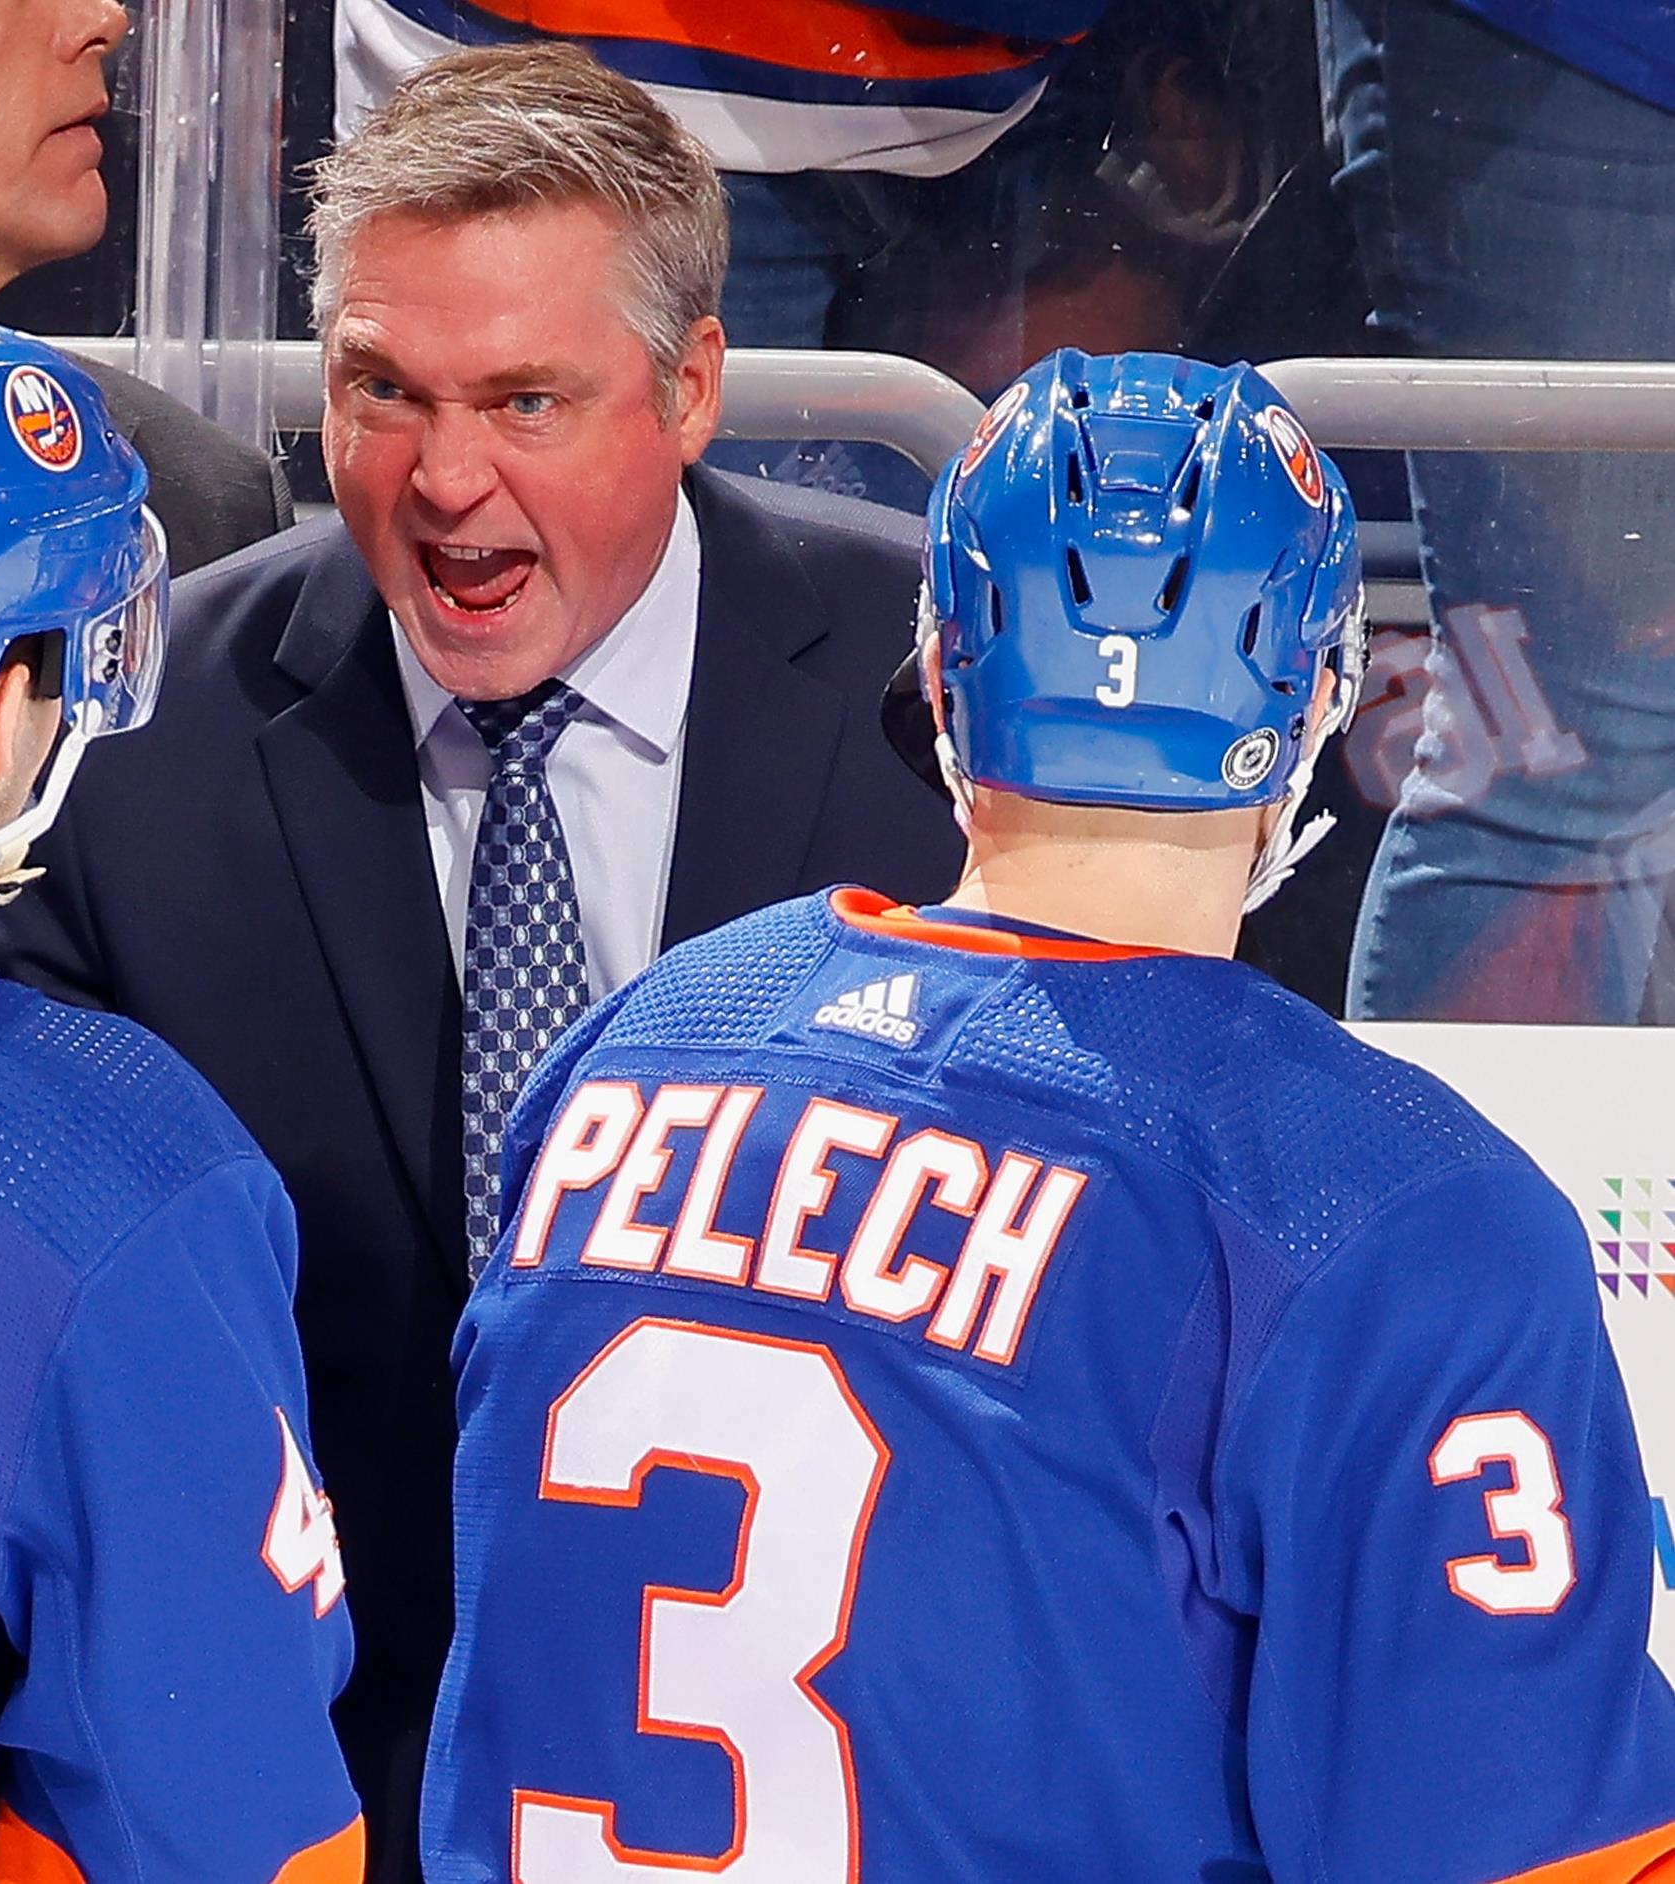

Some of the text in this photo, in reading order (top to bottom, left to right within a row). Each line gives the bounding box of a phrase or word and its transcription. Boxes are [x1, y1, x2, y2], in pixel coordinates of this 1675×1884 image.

[1095, 634, 1138, 708] 3
[814, 1003, 918, 1043] adidas
[511, 1080, 1088, 1367] PELECH
[259, 1405, 347, 1619] 4
[509, 1315, 892, 1884] 3
[1427, 1408, 1579, 1617] 3
